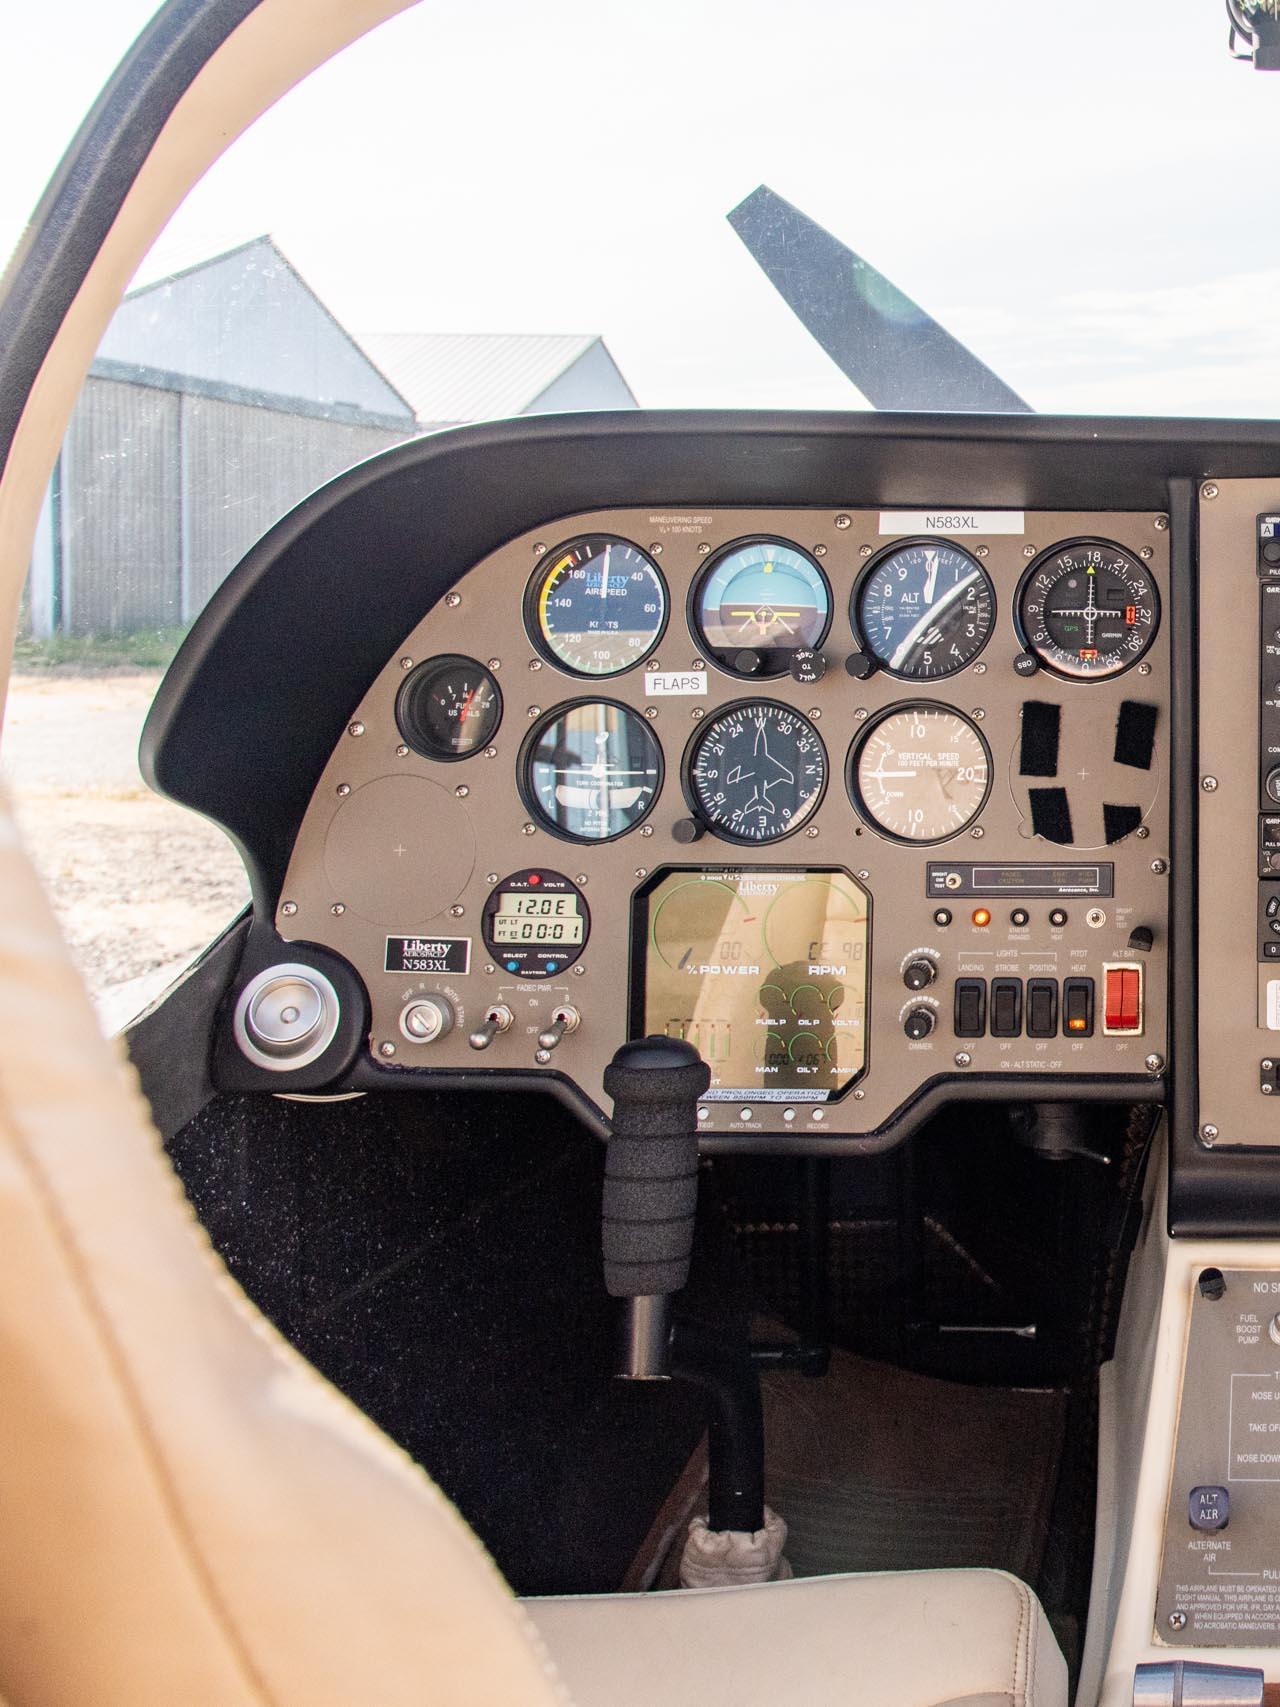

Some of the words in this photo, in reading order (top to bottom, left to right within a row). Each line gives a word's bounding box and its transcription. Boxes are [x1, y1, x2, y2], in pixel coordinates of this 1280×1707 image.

[926, 517, 978, 529] N583XL
[1057, 555, 1072, 568] 15
[1087, 551, 1100, 562] 18
[1113, 559, 1128, 571] 21
[569, 570, 585, 579] 160
[631, 572, 643, 581] 40
[1134, 580, 1147, 595] 24
[555, 599, 571, 607] 140
[901, 593, 919, 603] ALT
[644, 604, 656, 612] 60
[1140, 610, 1150, 624] 27
[1063, 625, 1079, 633] GPS
[564, 634, 581, 643] 120
[629, 638, 640, 647] 80
[1129, 635, 1143, 651] 30
[593, 651, 609, 660] 100
[1017, 660, 1032, 668] OBS
[654, 678, 699, 691] FLAPS
[729, 725, 743, 737] 24
[777, 722, 792, 734] 30
[910, 725, 925, 737] 10
[714, 744, 725, 756] 21
[797, 738, 810, 753] 33
[806, 765, 815, 773] N
[957, 768, 974, 780] 20
[908, 810, 923, 822] 10
[517, 900, 565, 914] 12.0E
[522, 924, 579, 939] 00:01
[403, 940, 451, 957] Liberty
[402, 950, 443, 958] AEROSPACE
[996, 950, 1018, 958] LIGHTS
[403, 960, 450, 971] N583XL
[700, 966, 759, 974] POWER
[809, 966, 846, 975] RPM
[958, 964, 985, 972] LANDING
[797, 1019, 811, 1027] OIL
[526, 1026, 540, 1034] OFF
[963, 1043, 976, 1051] OFF
[999, 1043, 1012, 1051] OFF
[1254, 1283, 1268, 1293] NO
[1252, 1392, 1272, 1400] NOSE
[1200, 1495, 1218, 1505] ALT
[1200, 1509, 1218, 1520] AIR
[1188, 1542, 1231, 1550] ALTERNATE
